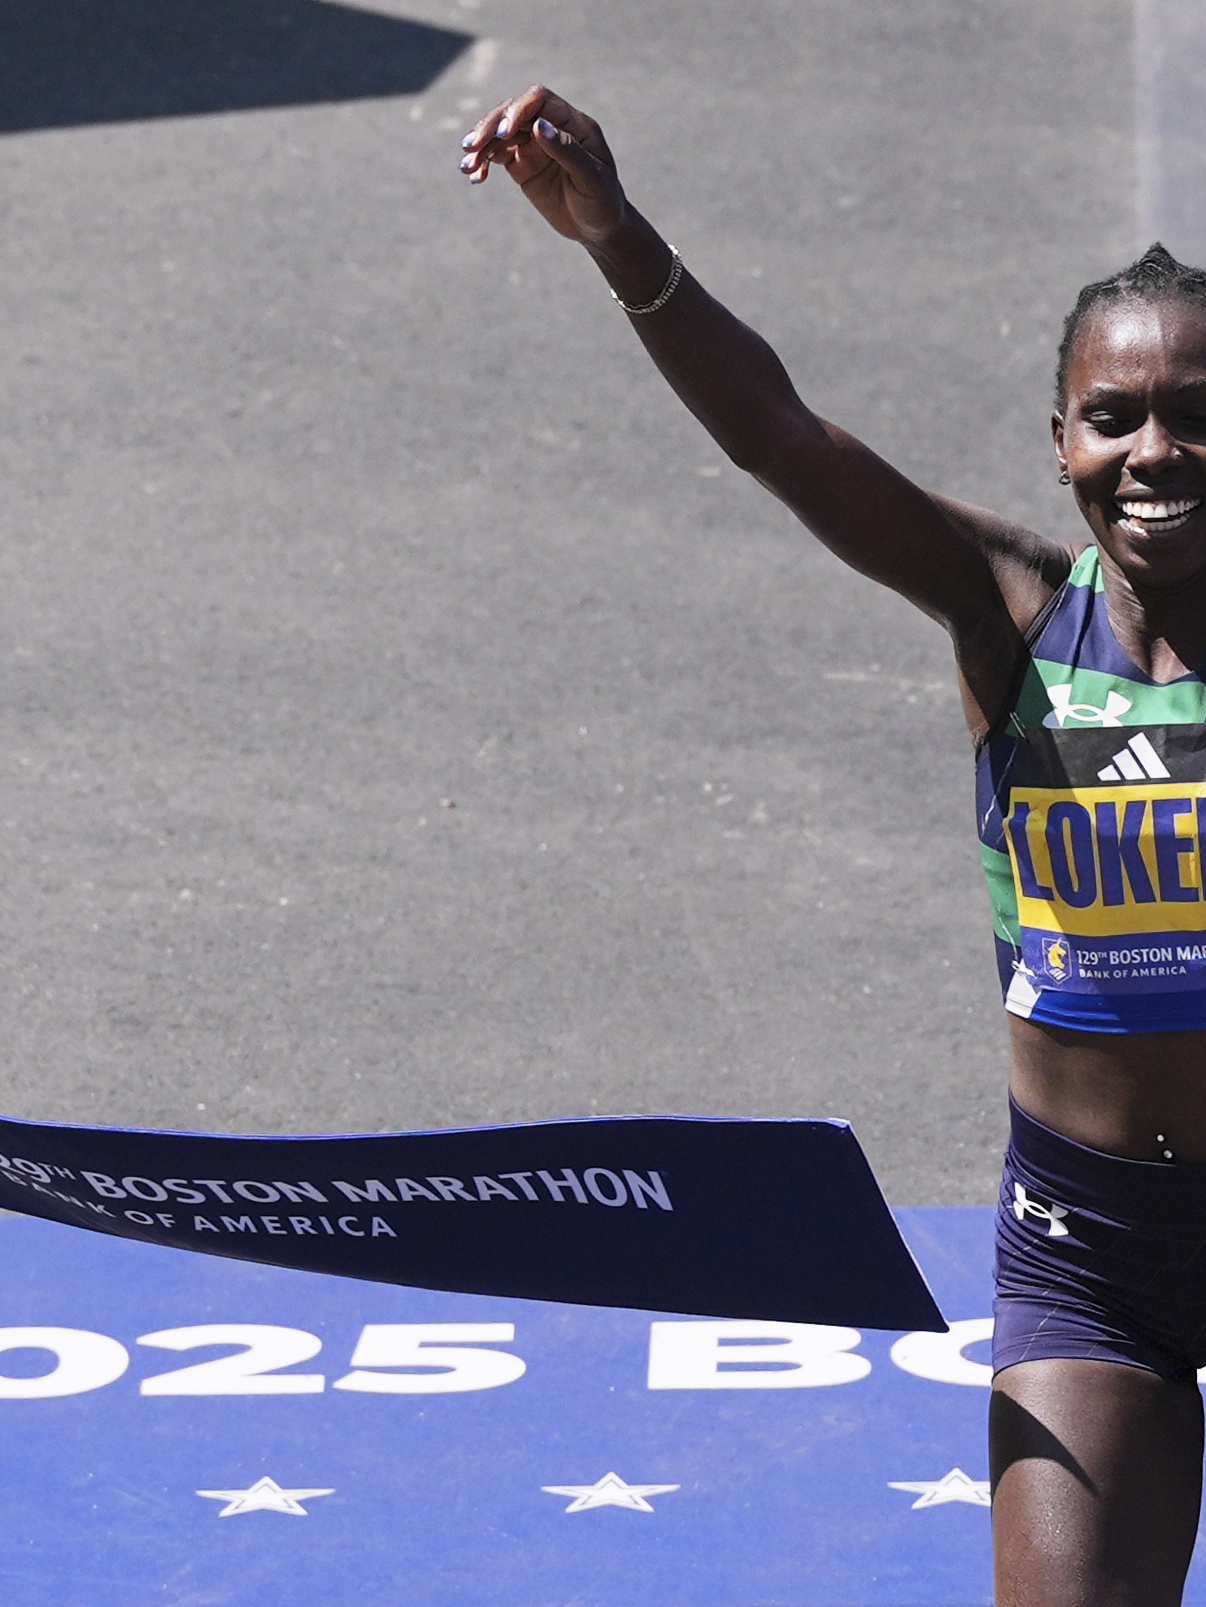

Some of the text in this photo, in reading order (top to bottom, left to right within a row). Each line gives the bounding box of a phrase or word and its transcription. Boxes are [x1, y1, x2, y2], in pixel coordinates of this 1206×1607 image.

[1076, 950, 1108, 966] 129TH
[1109, 947, 1173, 965] BOSTON
[1079, 965, 1187, 979] BANK OF AMERICA
[80, 1170, 329, 1204] BOSTON
[331, 1167, 674, 1211] MARATHON
[124, 1210, 176, 1228] OF
[193, 1215, 398, 1237] AMERICA
